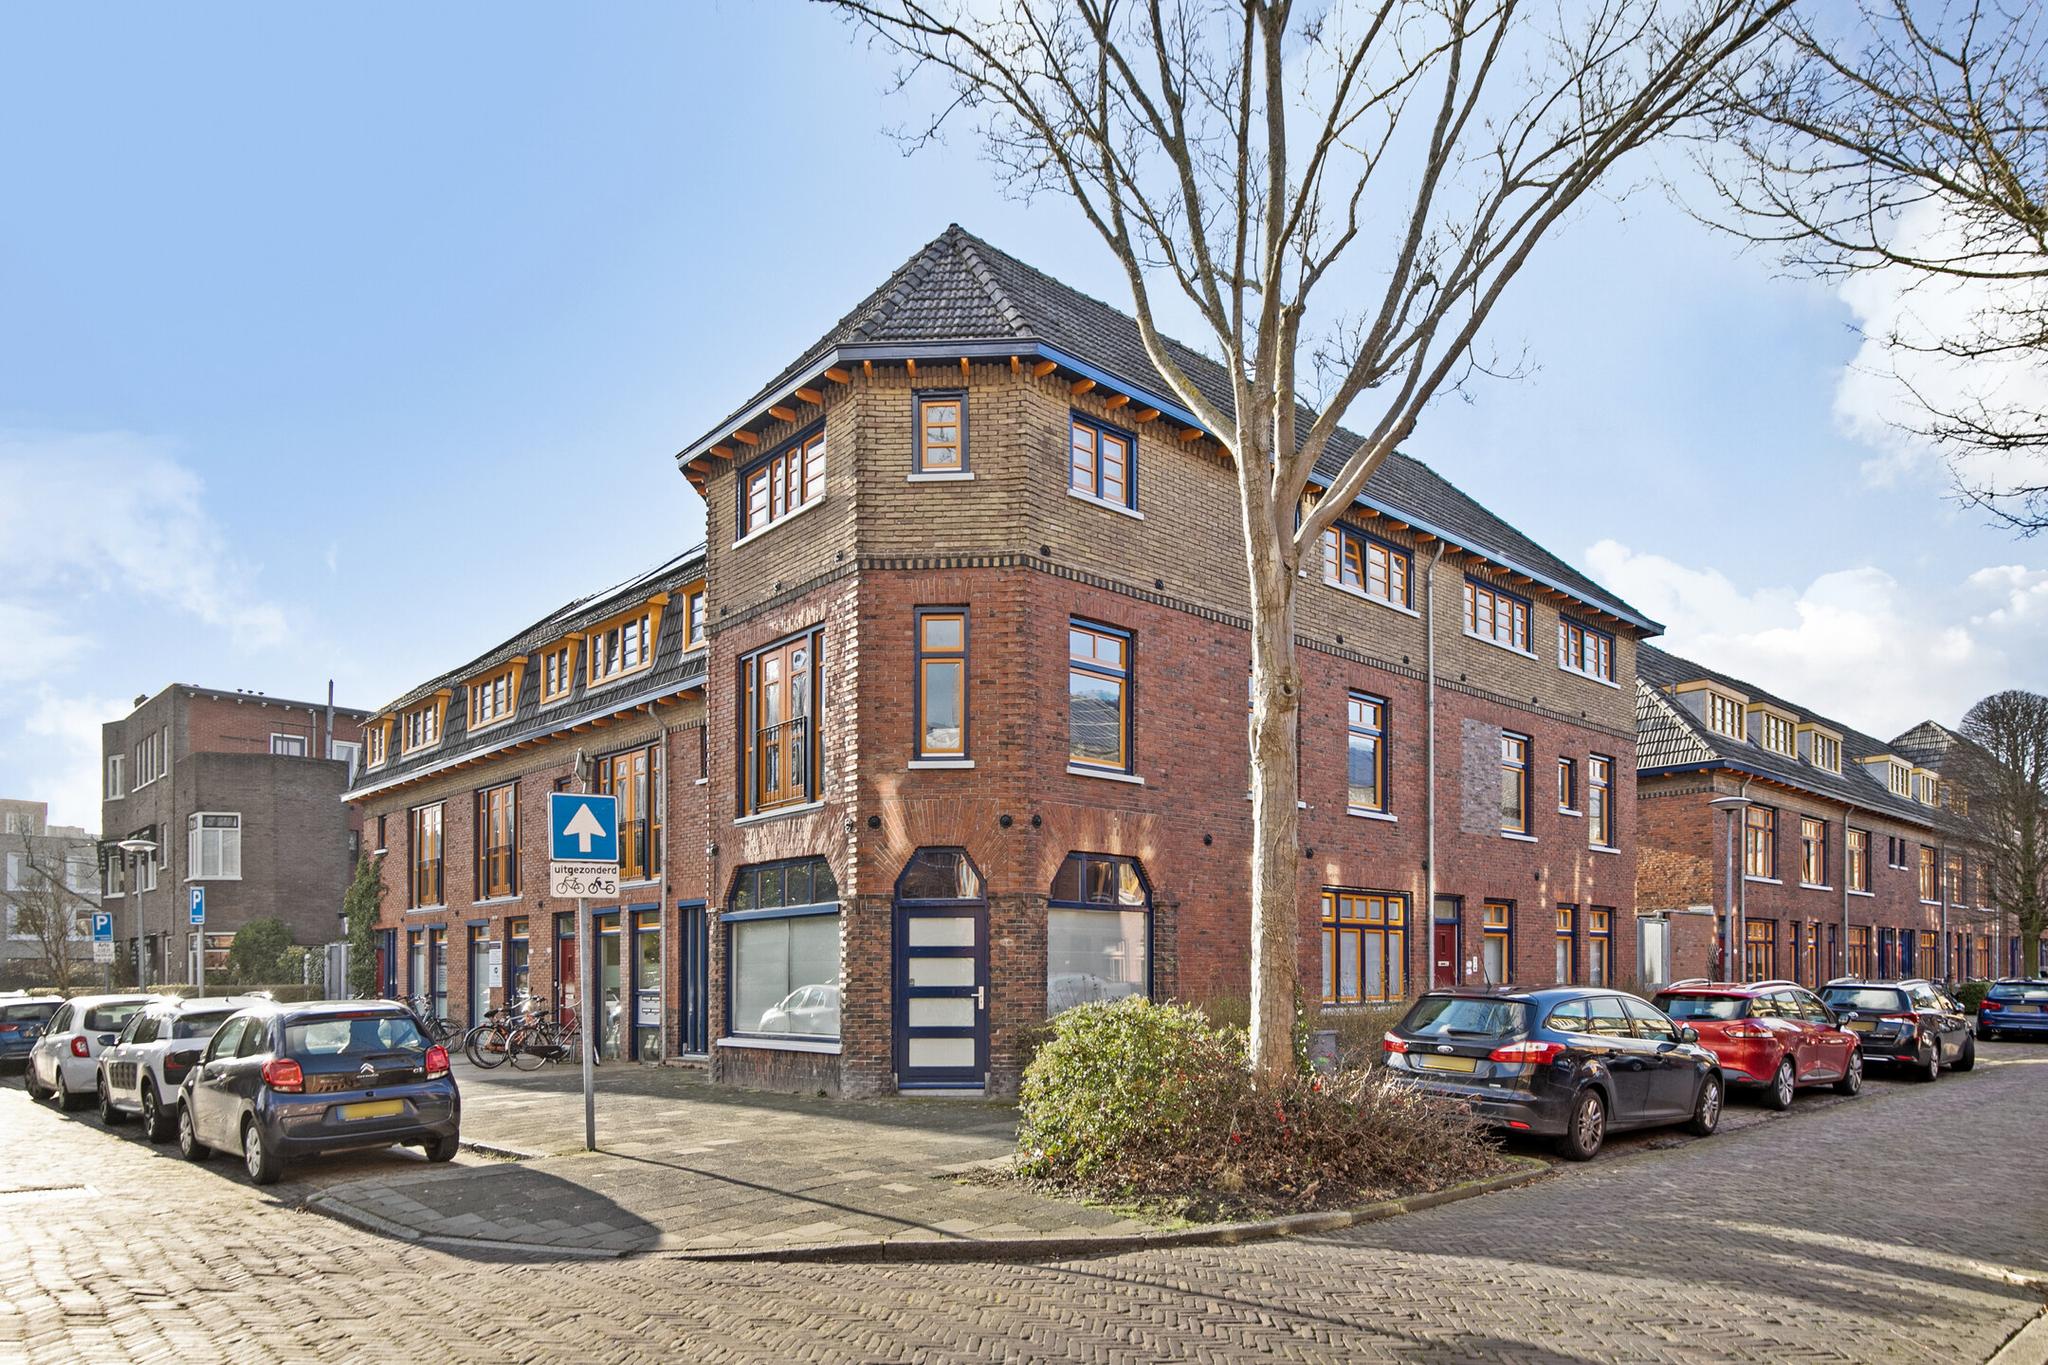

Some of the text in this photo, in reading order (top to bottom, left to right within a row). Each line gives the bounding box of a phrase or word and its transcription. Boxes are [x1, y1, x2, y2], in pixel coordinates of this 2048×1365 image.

[554, 866, 617, 876] uitgezonderd
[193, 891, 201, 909] P
[97, 916, 108, 930] P
